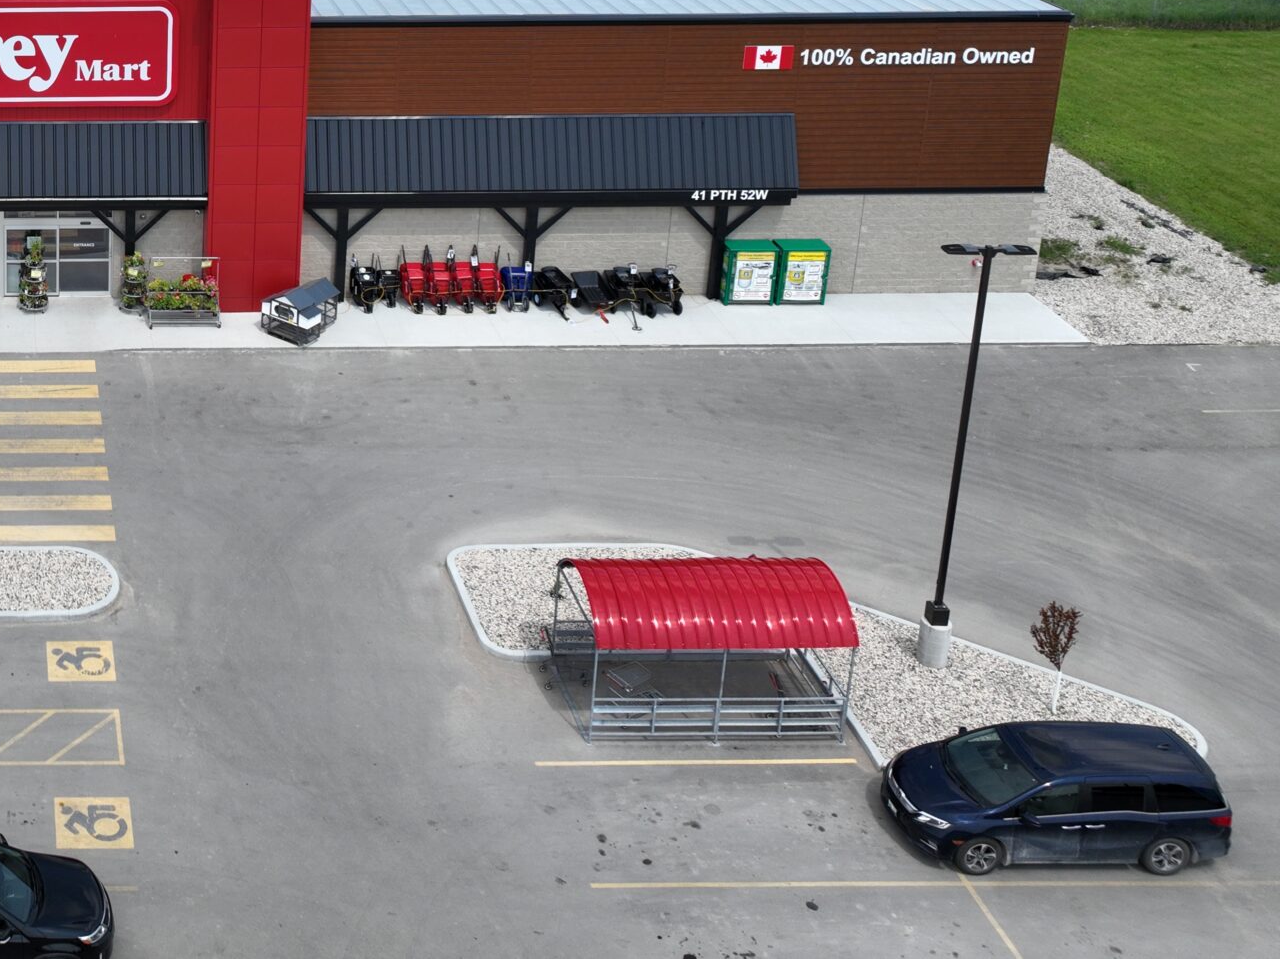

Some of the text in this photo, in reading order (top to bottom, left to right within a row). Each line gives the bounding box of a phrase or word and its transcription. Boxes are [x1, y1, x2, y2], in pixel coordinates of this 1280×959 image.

[800, 47, 1036, 66] 100% Canadian Owned
[75, 59, 151, 82] Mart
[691, 190, 769, 201] 41 PTH 52W
